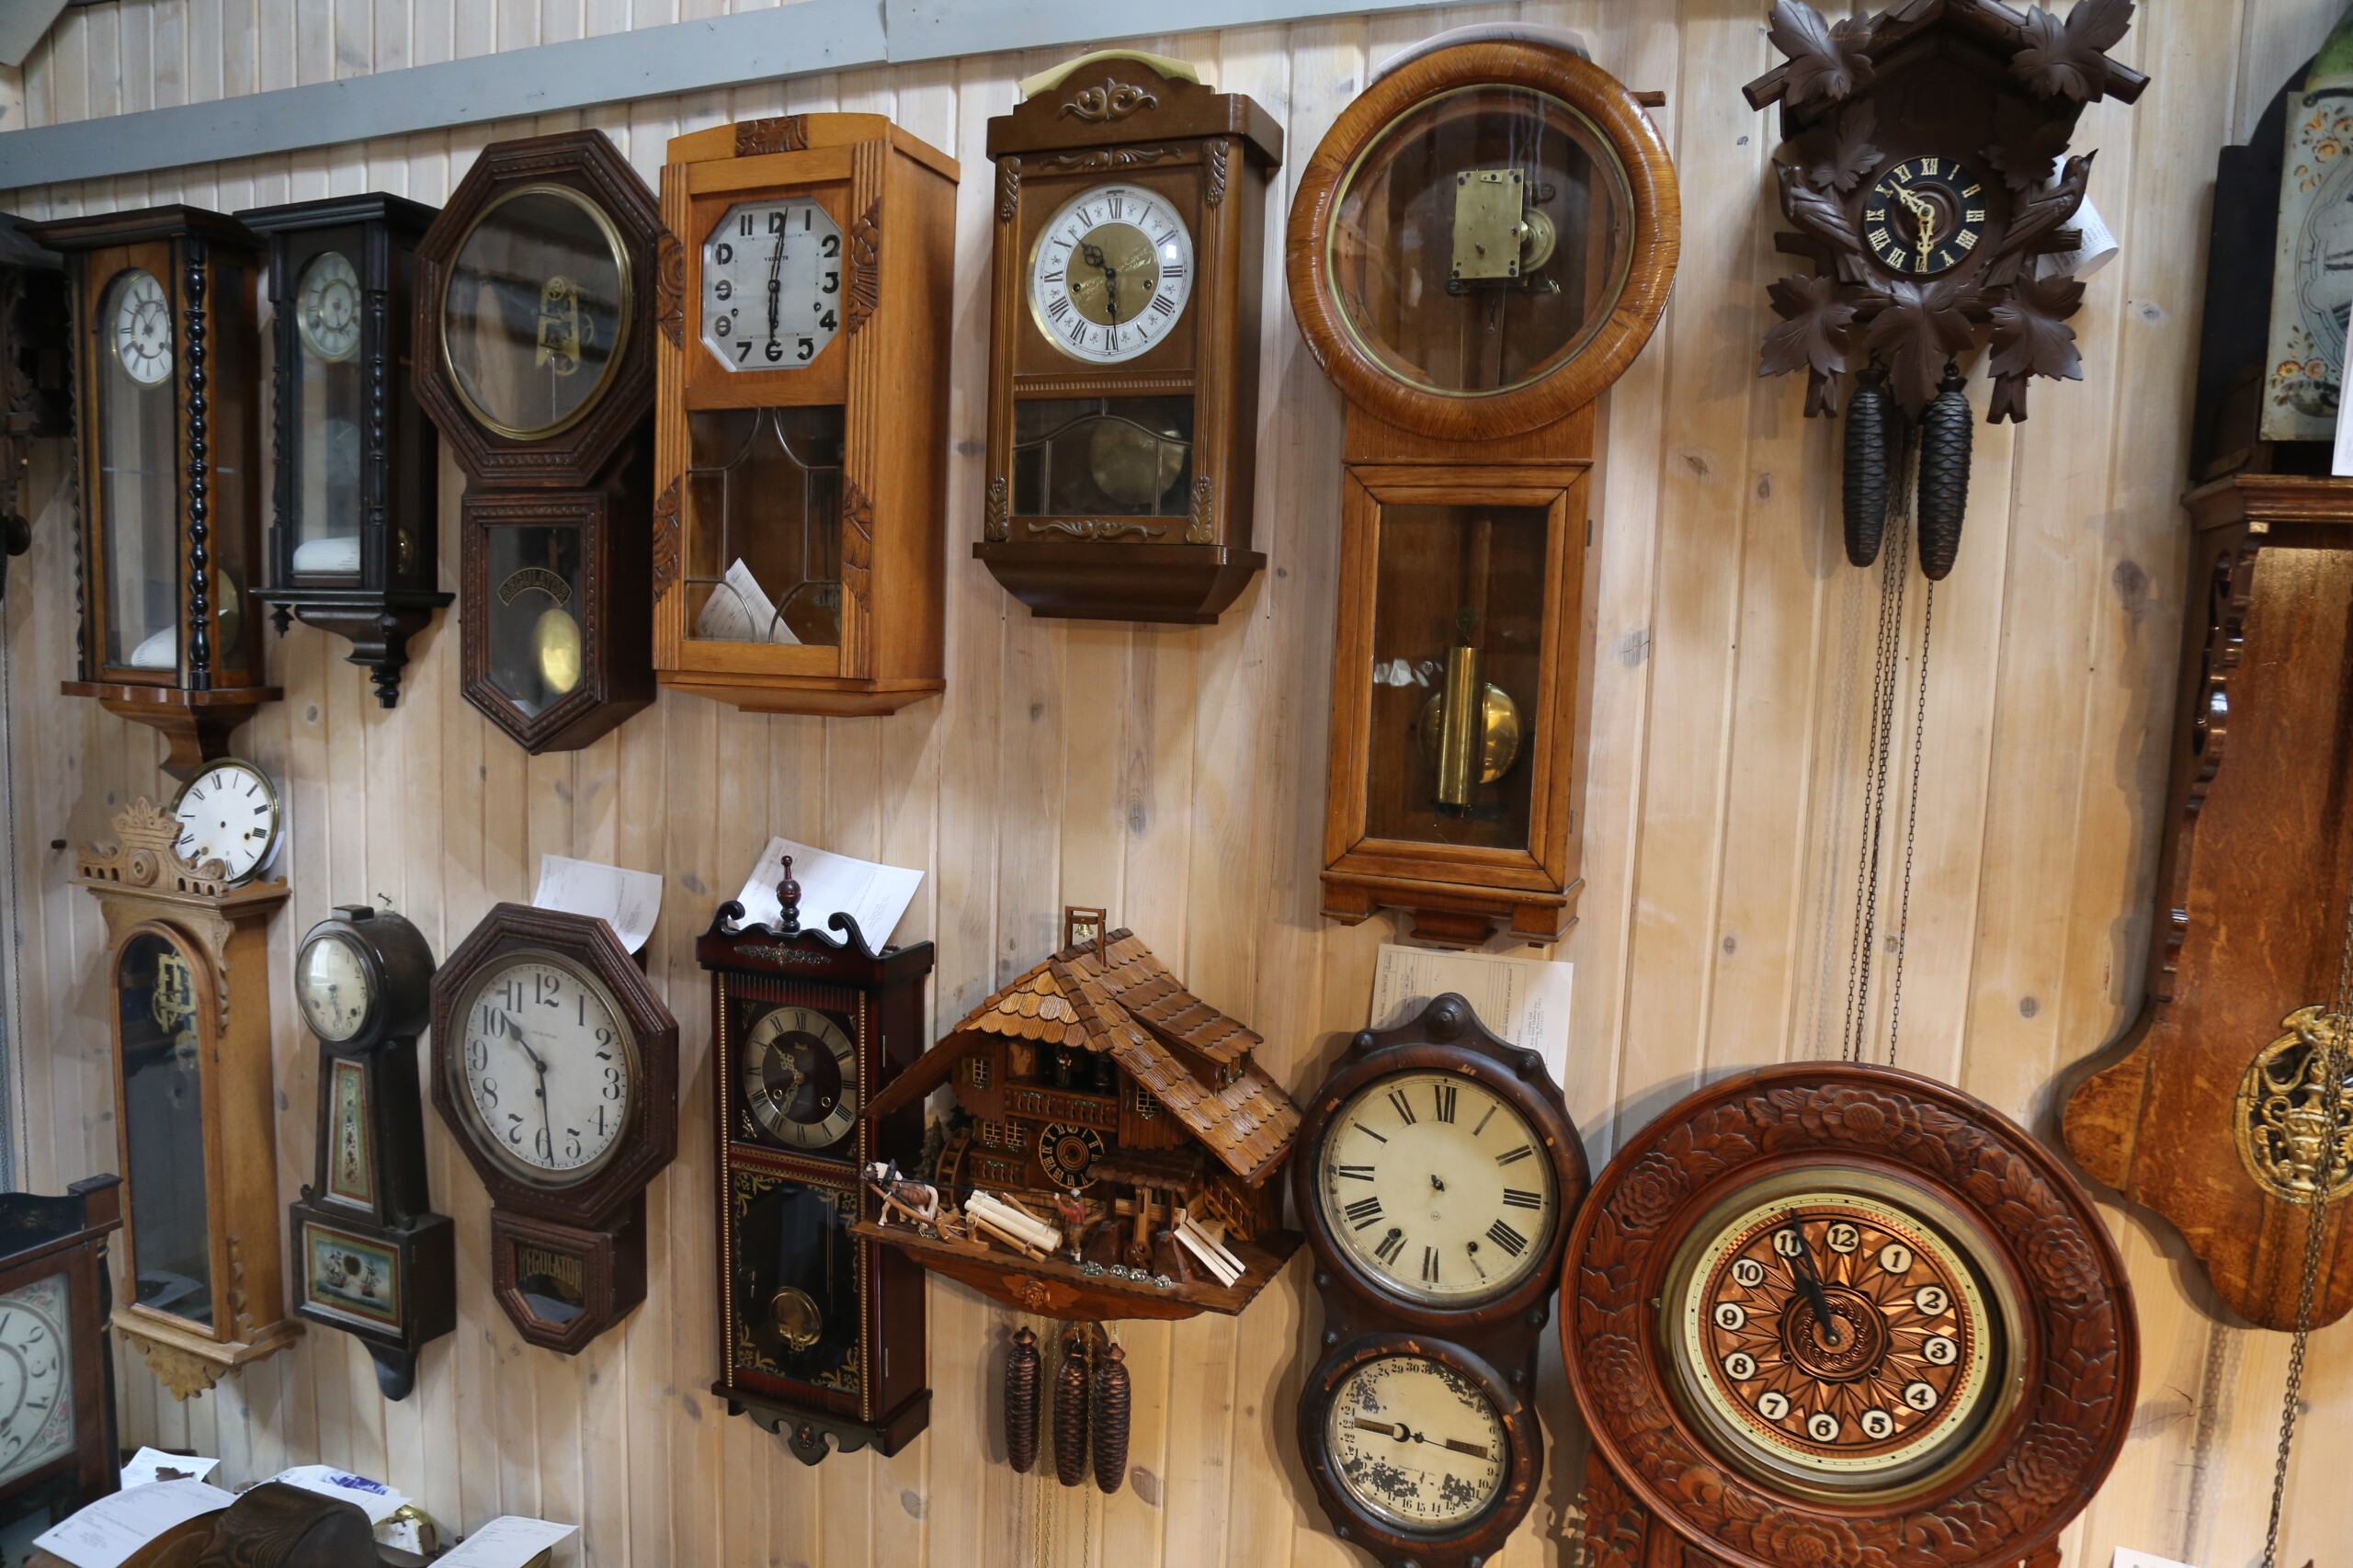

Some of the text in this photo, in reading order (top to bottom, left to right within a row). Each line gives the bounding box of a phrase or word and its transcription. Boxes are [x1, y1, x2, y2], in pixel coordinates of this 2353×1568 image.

[1893, 165, 1912, 183] XI
[1921, 158, 1938, 176] XII
[1875, 184, 1893, 199] X
[1961, 184, 1981, 199] II
[1107, 199, 1122, 219] XII
[1867, 209, 1885, 221] IX
[1966, 210, 1985, 222] III
[740, 214, 753, 236] 11
[805, 210, 811, 231] 1
[1076, 209, 1093, 230] XI
[822, 234, 840, 257] 2
[1053, 236, 1072, 252] X
[1156, 230, 1176, 246] II
[1868, 227, 1892, 251] VIII
[1955, 229, 1978, 250] IIII
[1887, 247, 1906, 268] VII
[1940, 250, 1955, 267] V
[1044, 270, 1063, 282] IX
[1163, 265, 1183, 278] III
[715, 279, 732, 301] 9
[822, 272, 838, 293] 3
[1049, 296, 1069, 322] VIII
[1152, 294, 1175, 316] IIII
[715, 316, 731, 336] 8
[819, 310, 836, 331] 4
[1070, 319, 1087, 344] VII
[1106, 329, 1119, 350] VI
[1137, 324, 1147, 341] V
[737, 342, 752, 362] 7
[766, 340, 782, 361] 6
[797, 338, 813, 359] 5
[500, 570, 569, 601] REGULATOR
[506, 980, 522, 1013] 11
[536, 973, 560, 1007] 12
[578, 994, 585, 1026] 1
[483, 1005, 506, 1038] 10
[770, 1016, 783, 1035] XI
[795, 1012, 806, 1030] XII
[595, 1028, 611, 1061] 2
[752, 1039, 767, 1051] X
[472, 1040, 488, 1071] 9
[836, 1050, 850, 1060] II
[747, 1065, 761, 1076] IX
[482, 1077, 498, 1108] 8
[603, 1068, 620, 1100] 3
[843, 1080, 856, 1090] III
[752, 1089, 767, 1108] VIII
[1432, 1085, 1459, 1124] XII
[835, 1104, 852, 1122] IIII
[1388, 1089, 1416, 1129] XI
[507, 1113, 524, 1144] 7
[587, 1105, 608, 1136] 4
[770, 1112, 784, 1132] VII
[822, 1122, 832, 1138] V
[797, 1125, 805, 1142] VI
[1354, 1121, 1388, 1149] X
[535, 1128, 551, 1160] 6
[566, 1128, 581, 1159] 5
[1495, 1144, 1532, 1166] II
[1339, 1162, 1374, 1181] IX
[1503, 1188, 1541, 1210] III
[1345, 1196, 1386, 1232] VIII
[1485, 1219, 1529, 1257] IIII
[1779, 1234, 1800, 1253] 11
[1833, 1229, 1855, 1247] 12
[1374, 1237, 1408, 1267] VII
[1891, 1251, 1903, 1267] 1
[518, 1245, 583, 1295] REGULATOR
[1422, 1246, 1438, 1283] VI
[1737, 1263, 1758, 1279] 10
[1923, 1291, 1941, 1310] 2
[1722, 1308, 1737, 1325] 9
[1932, 1341, 1949, 1359] 3
[1379, 1368, 1390, 1377] 28
[1392, 1364, 1404, 1373] 29
[1406, 1362, 1419, 1373] 30
[1733, 1358, 1747, 1374] 8
[1911, 1388, 1929, 1405] 4
[1767, 1398, 1780, 1415] 7
[1343, 1419, 1354, 1429] 23
[1815, 1419, 1831, 1437] 6
[1870, 1415, 1885, 1434] 5
[1344, 1434, 1355, 1443] 22
[1487, 1468, 1494, 1476] 9
[1478, 1479, 1488, 1489] 10
[1403, 1498, 1412, 1509] 16
[1416, 1502, 1426, 1513] 15
